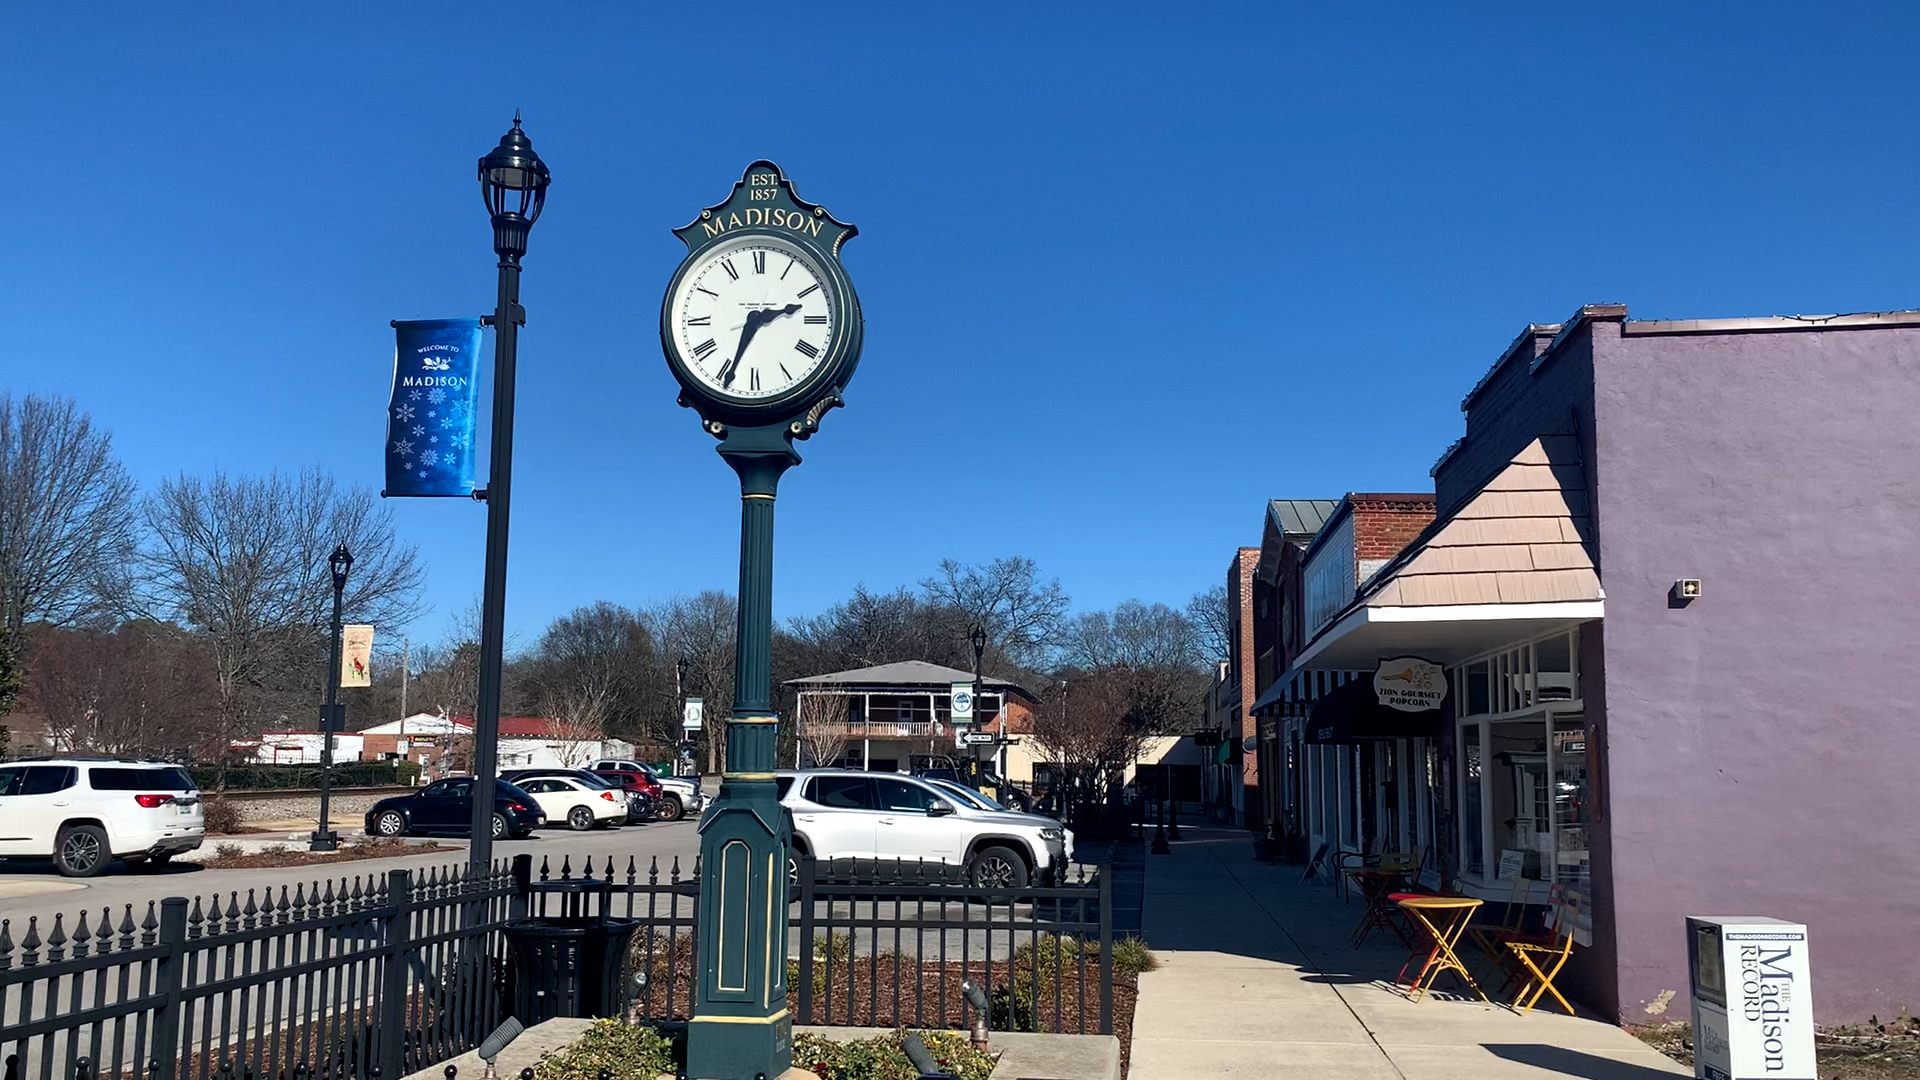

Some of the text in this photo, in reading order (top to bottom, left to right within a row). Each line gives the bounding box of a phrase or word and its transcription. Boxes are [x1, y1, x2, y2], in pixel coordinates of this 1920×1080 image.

[751, 174, 778, 186] EST.
[750, 188, 777, 201] 1857
[702, 207, 825, 239] MADISON
[418, 345, 449, 353] WELCOME
[403, 376, 467, 387] MADISON
[1379, 688, 1441, 699] ZION GOURMET
[1390, 698, 1430, 707] POPCORN
[1741, 945, 1760, 1021] RECORD
[1758, 945, 1794, 1072] Madison
